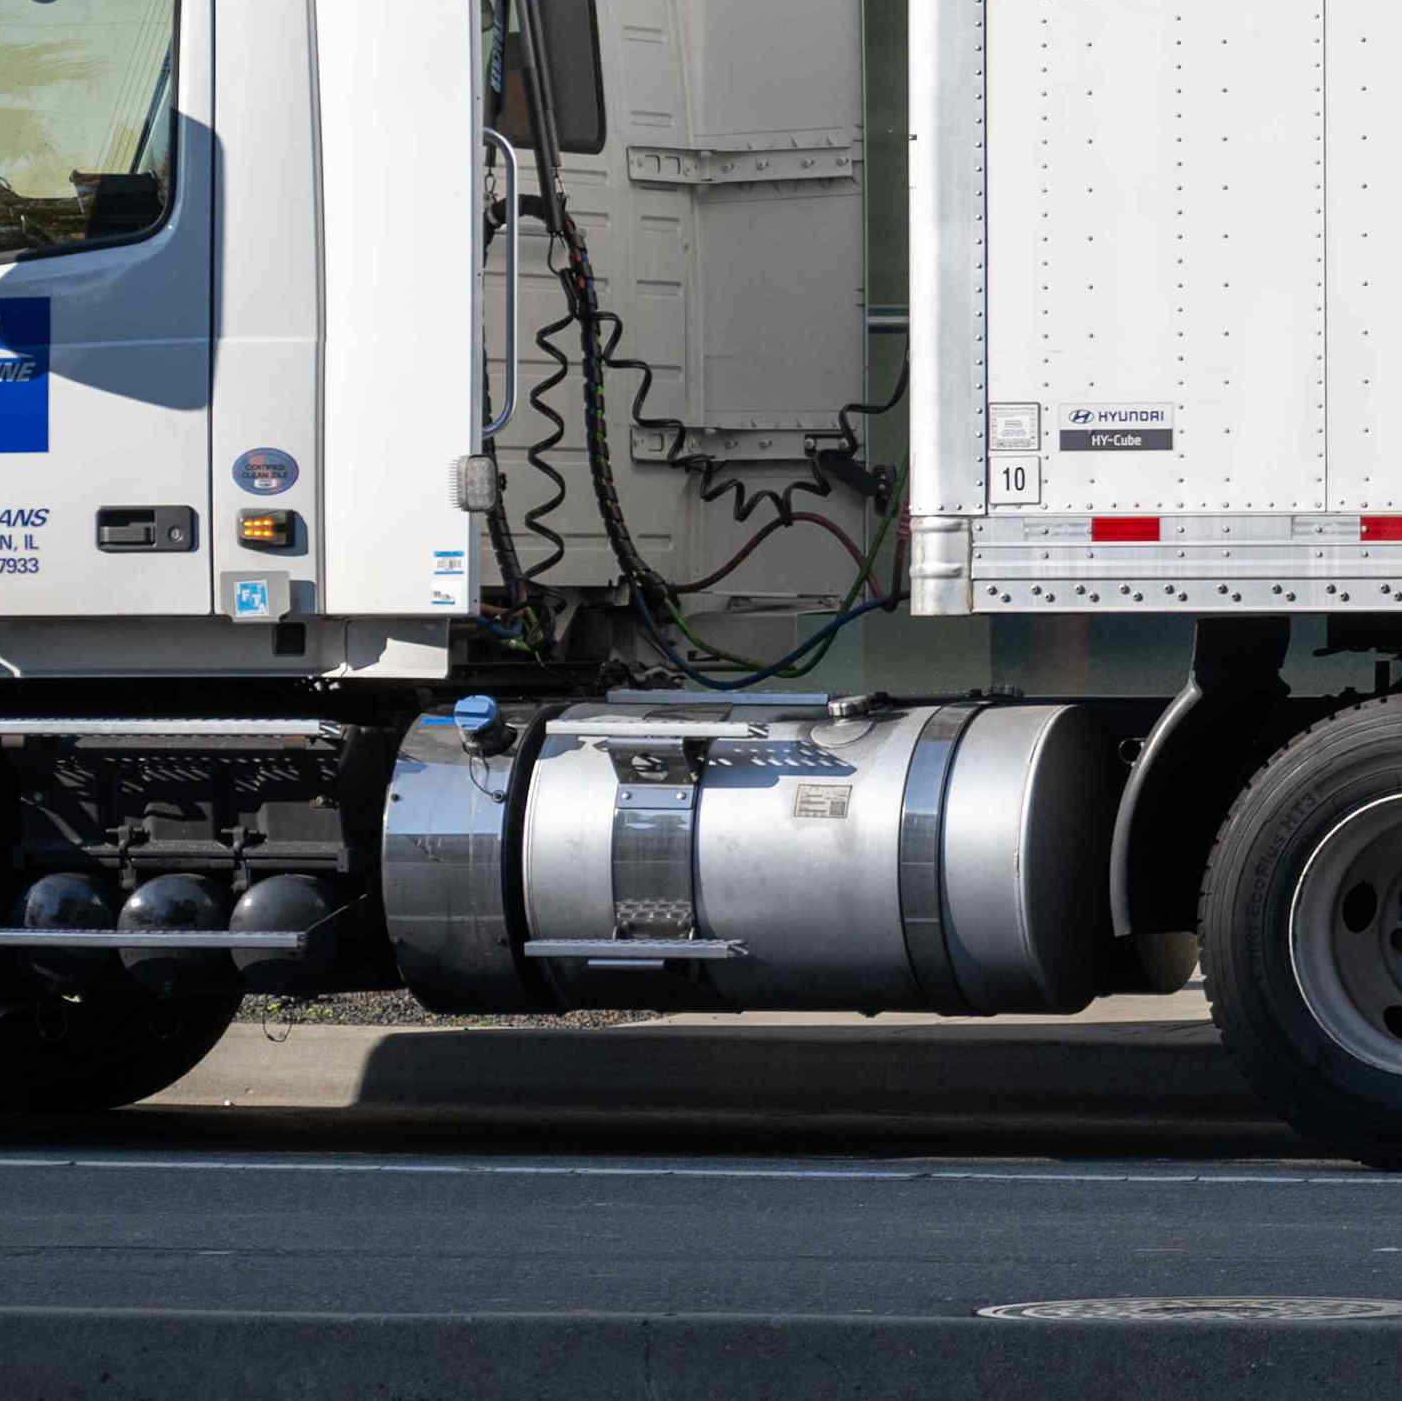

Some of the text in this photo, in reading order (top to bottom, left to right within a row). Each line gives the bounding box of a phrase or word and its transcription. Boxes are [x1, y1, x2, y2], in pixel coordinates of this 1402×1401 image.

[1097, 410, 1164, 422] HYUNDAI
[1091, 434, 1142, 447] HY-Cube
[1002, 466, 1026, 491] 10
[24, 534, 40, 550] IL
